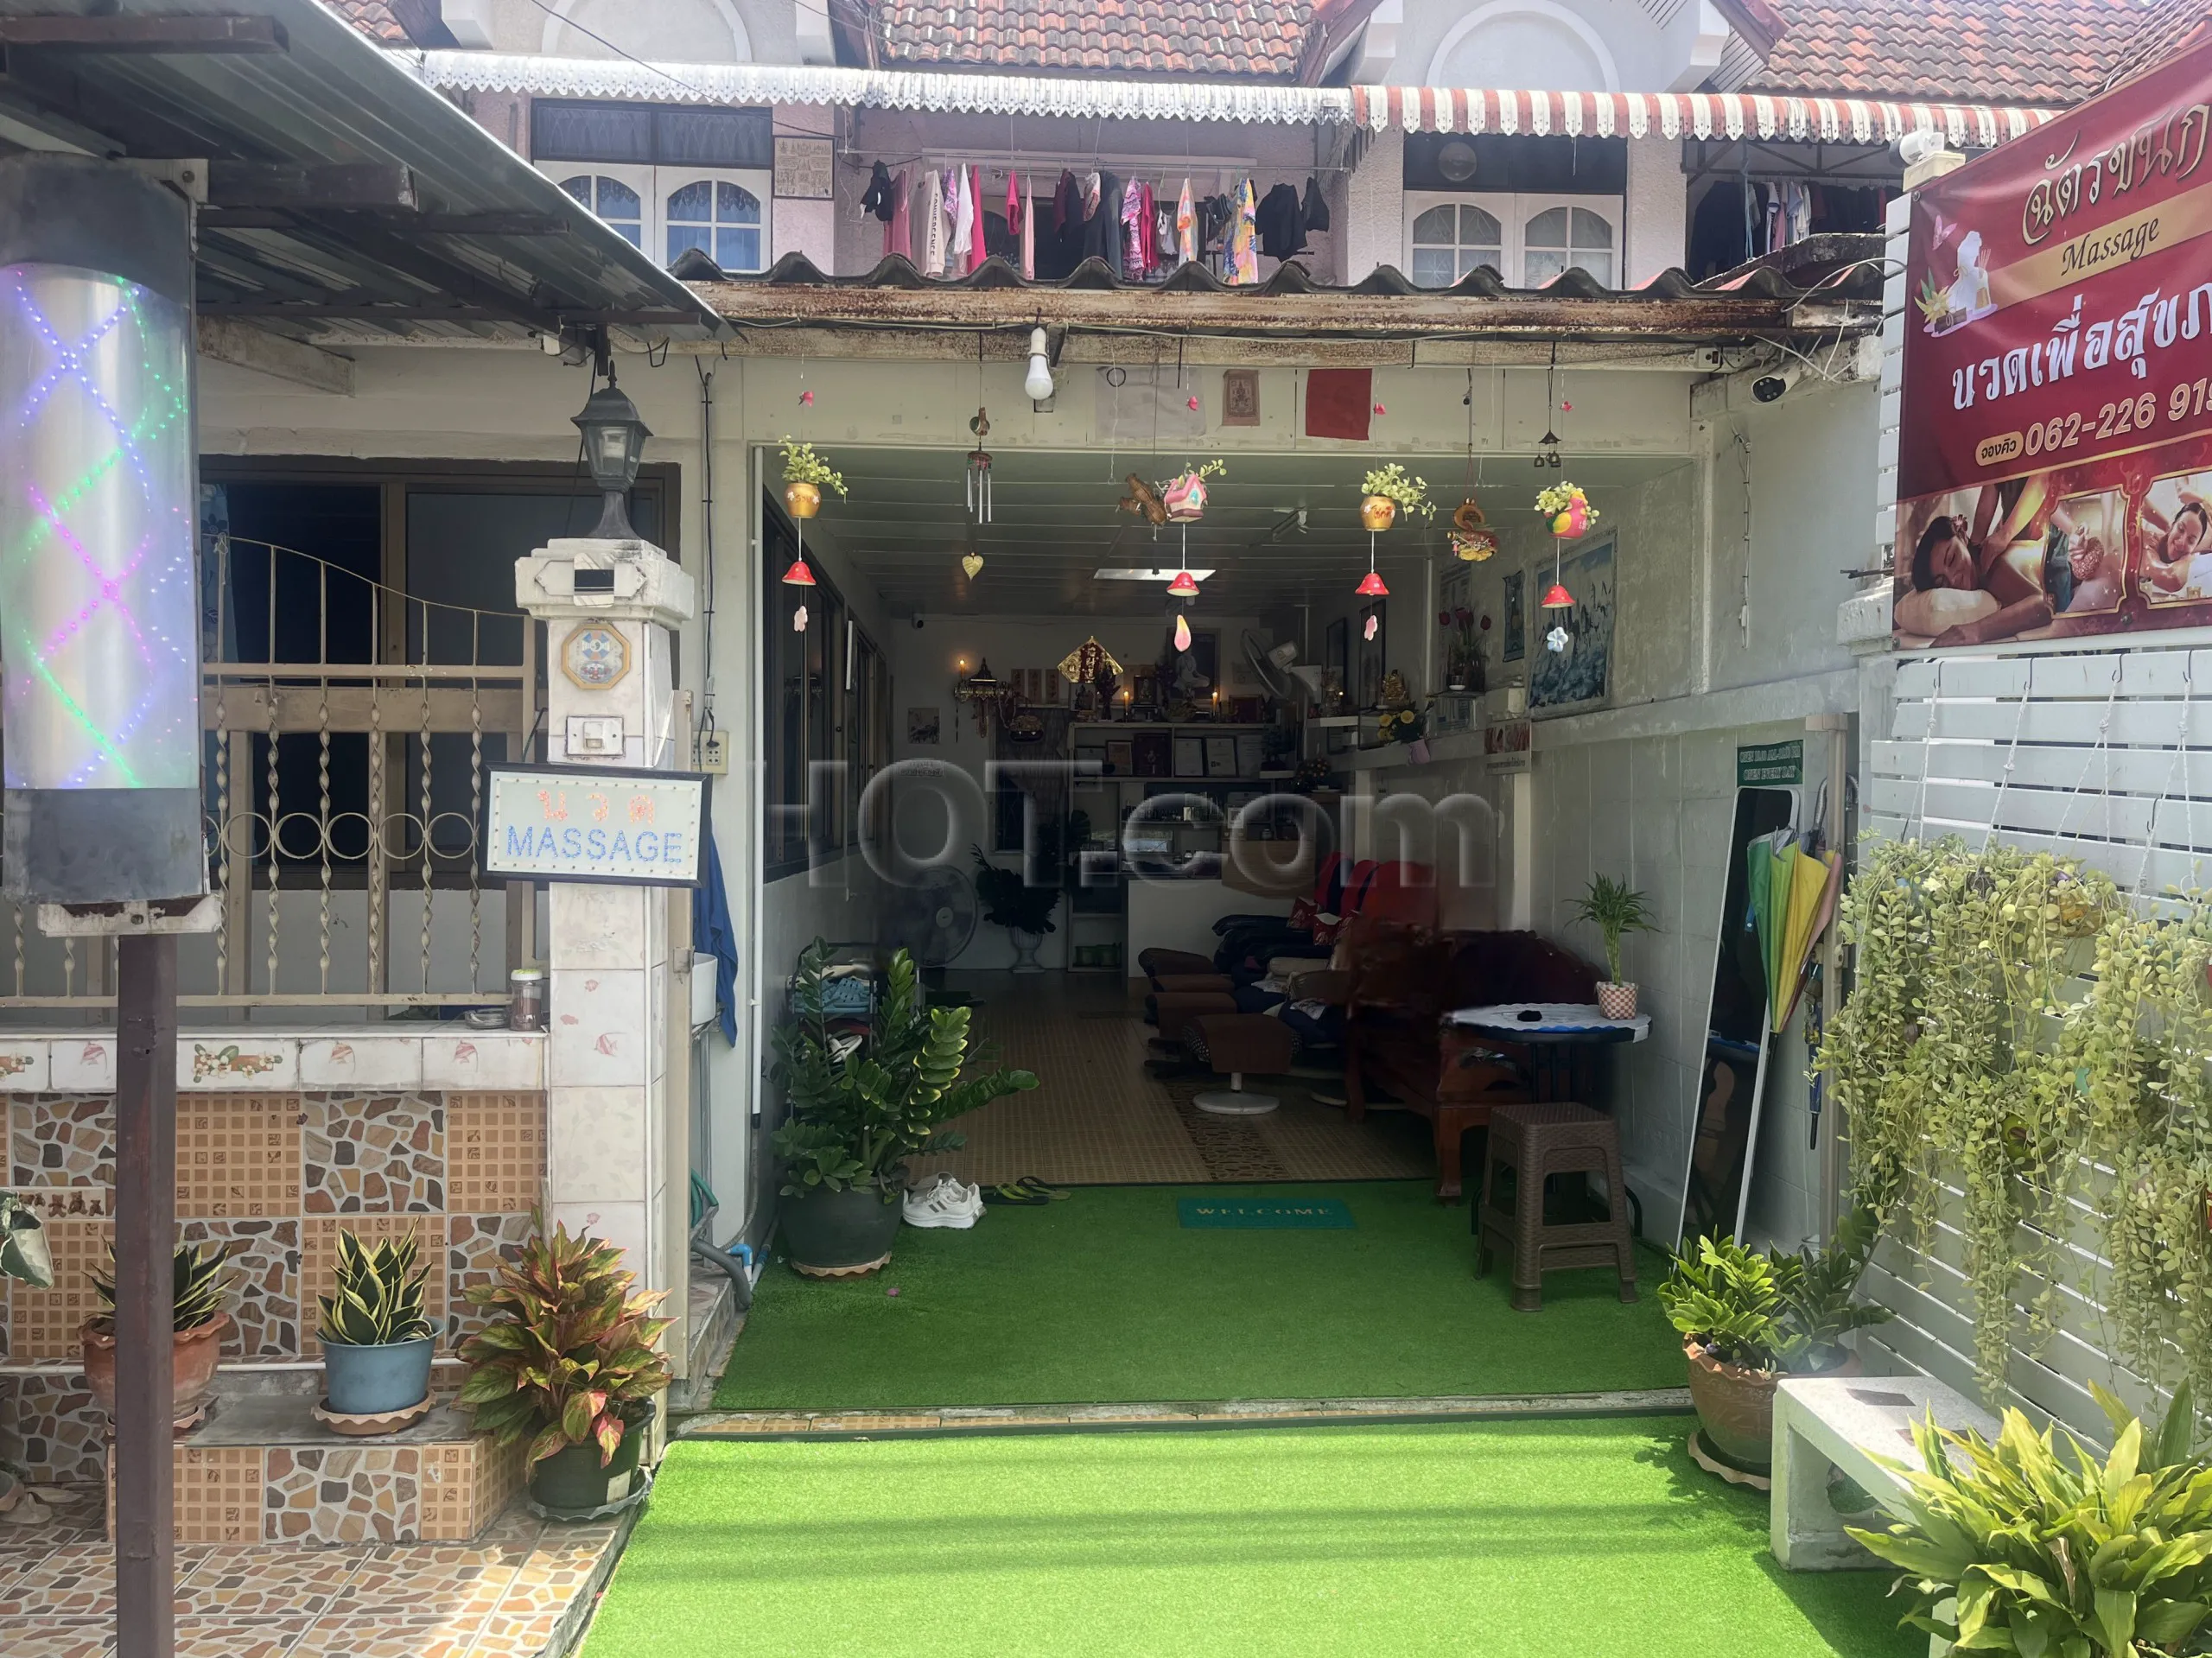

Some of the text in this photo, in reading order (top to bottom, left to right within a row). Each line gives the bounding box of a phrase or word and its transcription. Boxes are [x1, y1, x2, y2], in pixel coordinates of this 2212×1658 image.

[2061, 218, 2160, 276] Massage
[1980, 378, 2212, 460] จองคิว 062-226 91
[537, 789, 654, 825] นวด
[505, 825, 683, 863] MASSAGE
